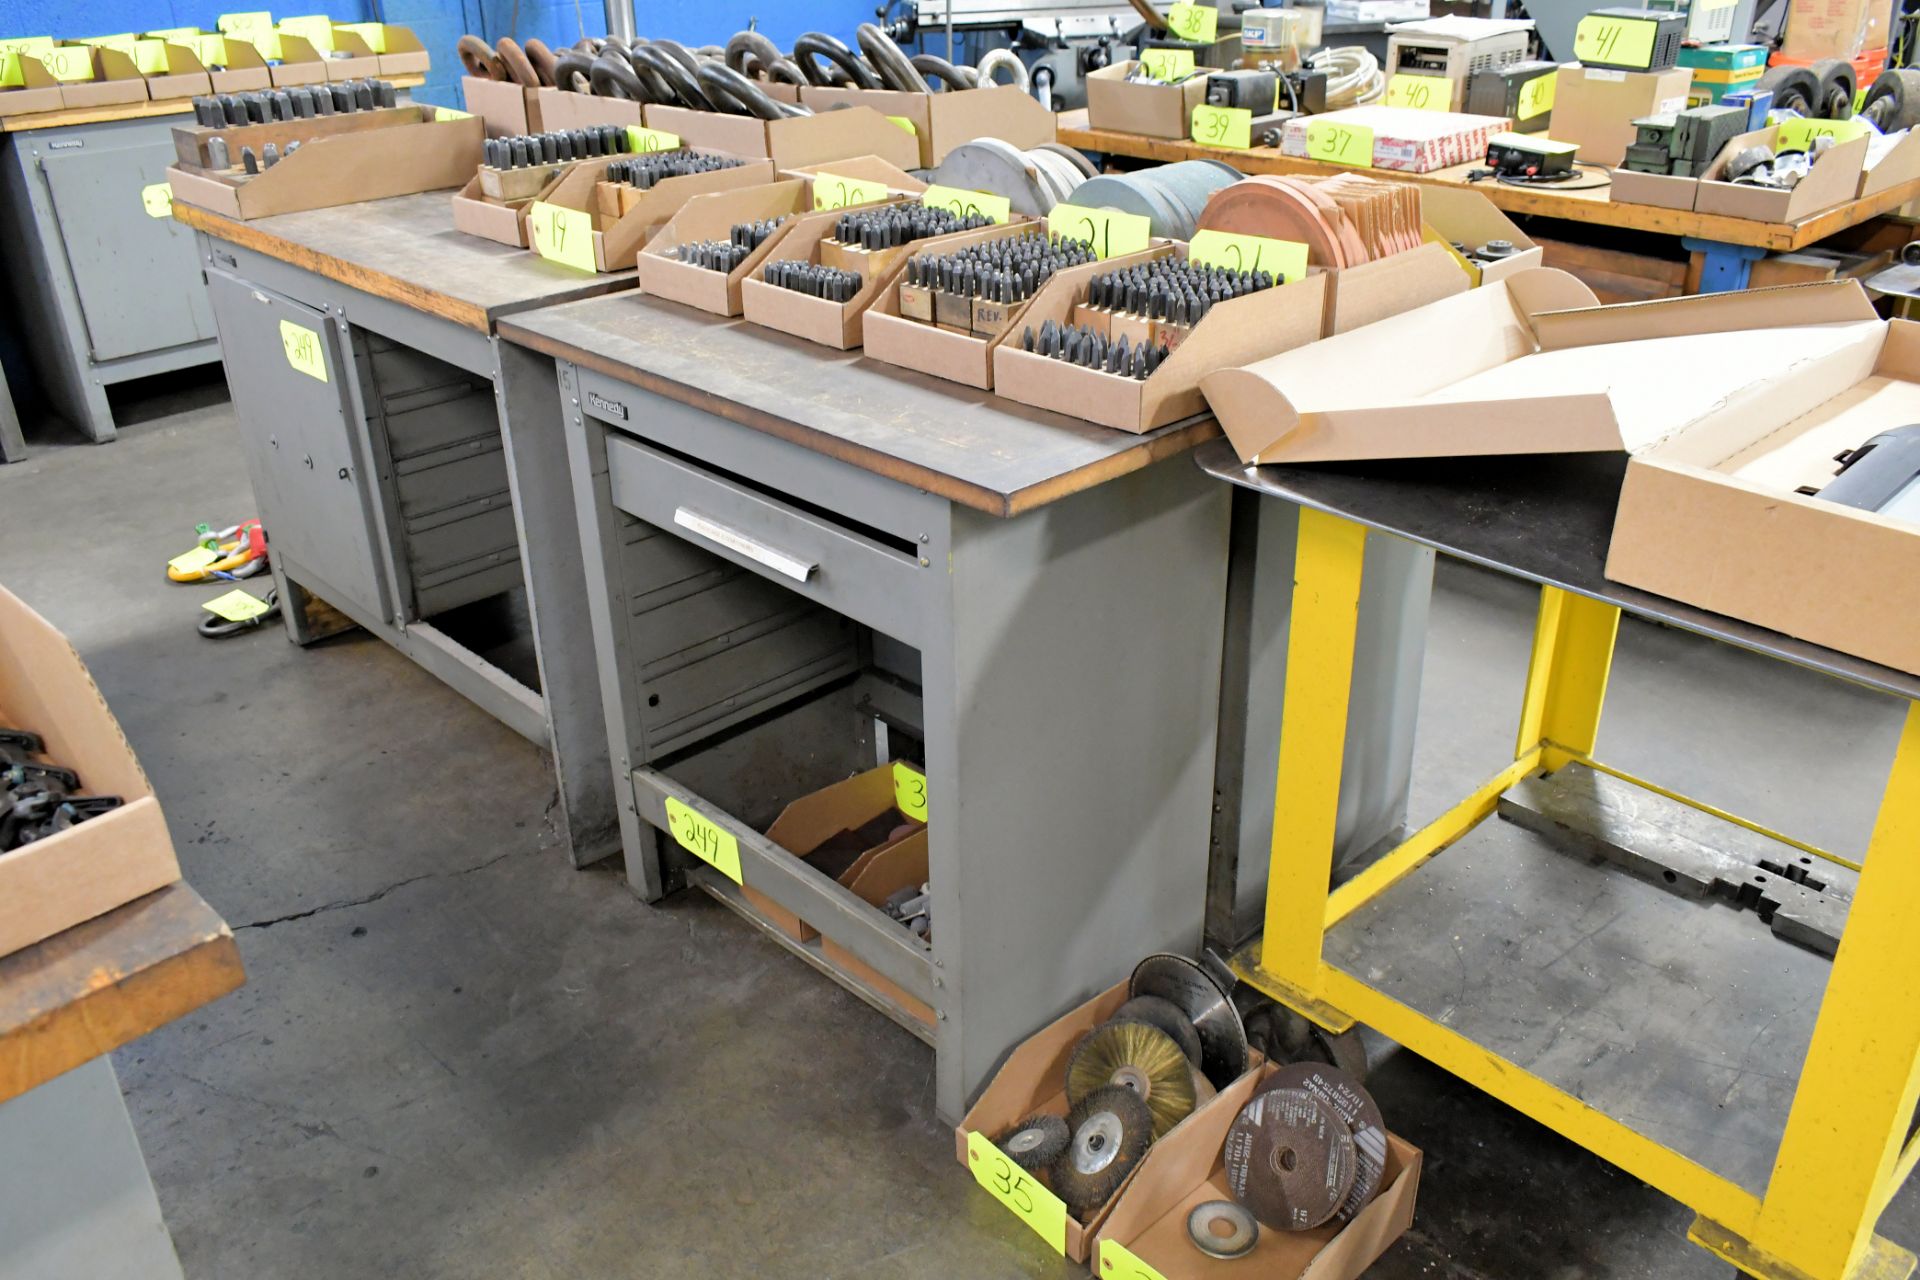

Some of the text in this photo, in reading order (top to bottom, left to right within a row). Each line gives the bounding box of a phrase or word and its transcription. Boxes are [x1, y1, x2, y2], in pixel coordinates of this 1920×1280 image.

[1185, 9, 1204, 33] 38
[1597, 26, 1622, 60] 41
[1159, 54, 1176, 82] 39
[1406, 83, 1430, 108] 40
[1206, 113, 1230, 142] 39
[1322, 128, 1352, 156] 37
[552, 210, 567, 253] 19
[976, 308, 1003, 323] REV.
[291, 333, 314, 375] 249
[589, 393, 625, 418] Kennedy
[684, 813, 719, 863] 249
[993, 1157, 1033, 1213] 35
